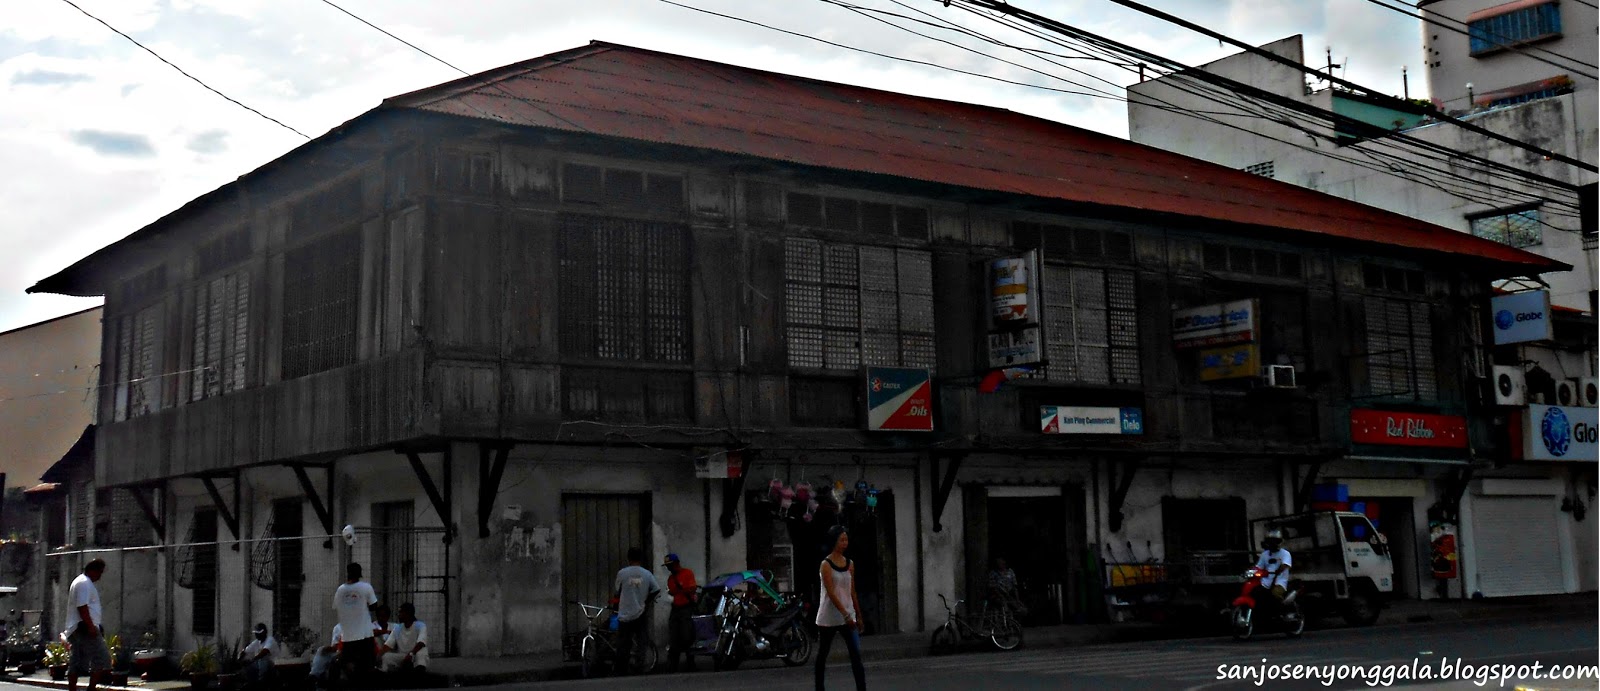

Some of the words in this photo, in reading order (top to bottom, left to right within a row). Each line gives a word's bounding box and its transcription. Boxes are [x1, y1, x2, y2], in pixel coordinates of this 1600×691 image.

[1516, 311, 1543, 323] Globe
[910, 405, 929, 416] Oils
[1123, 419, 1141, 431] Delo
[1386, 416, 1405, 438] Red
[1407, 418, 1436, 439] Ribbon
[1574, 422, 1599, 443] Glo
